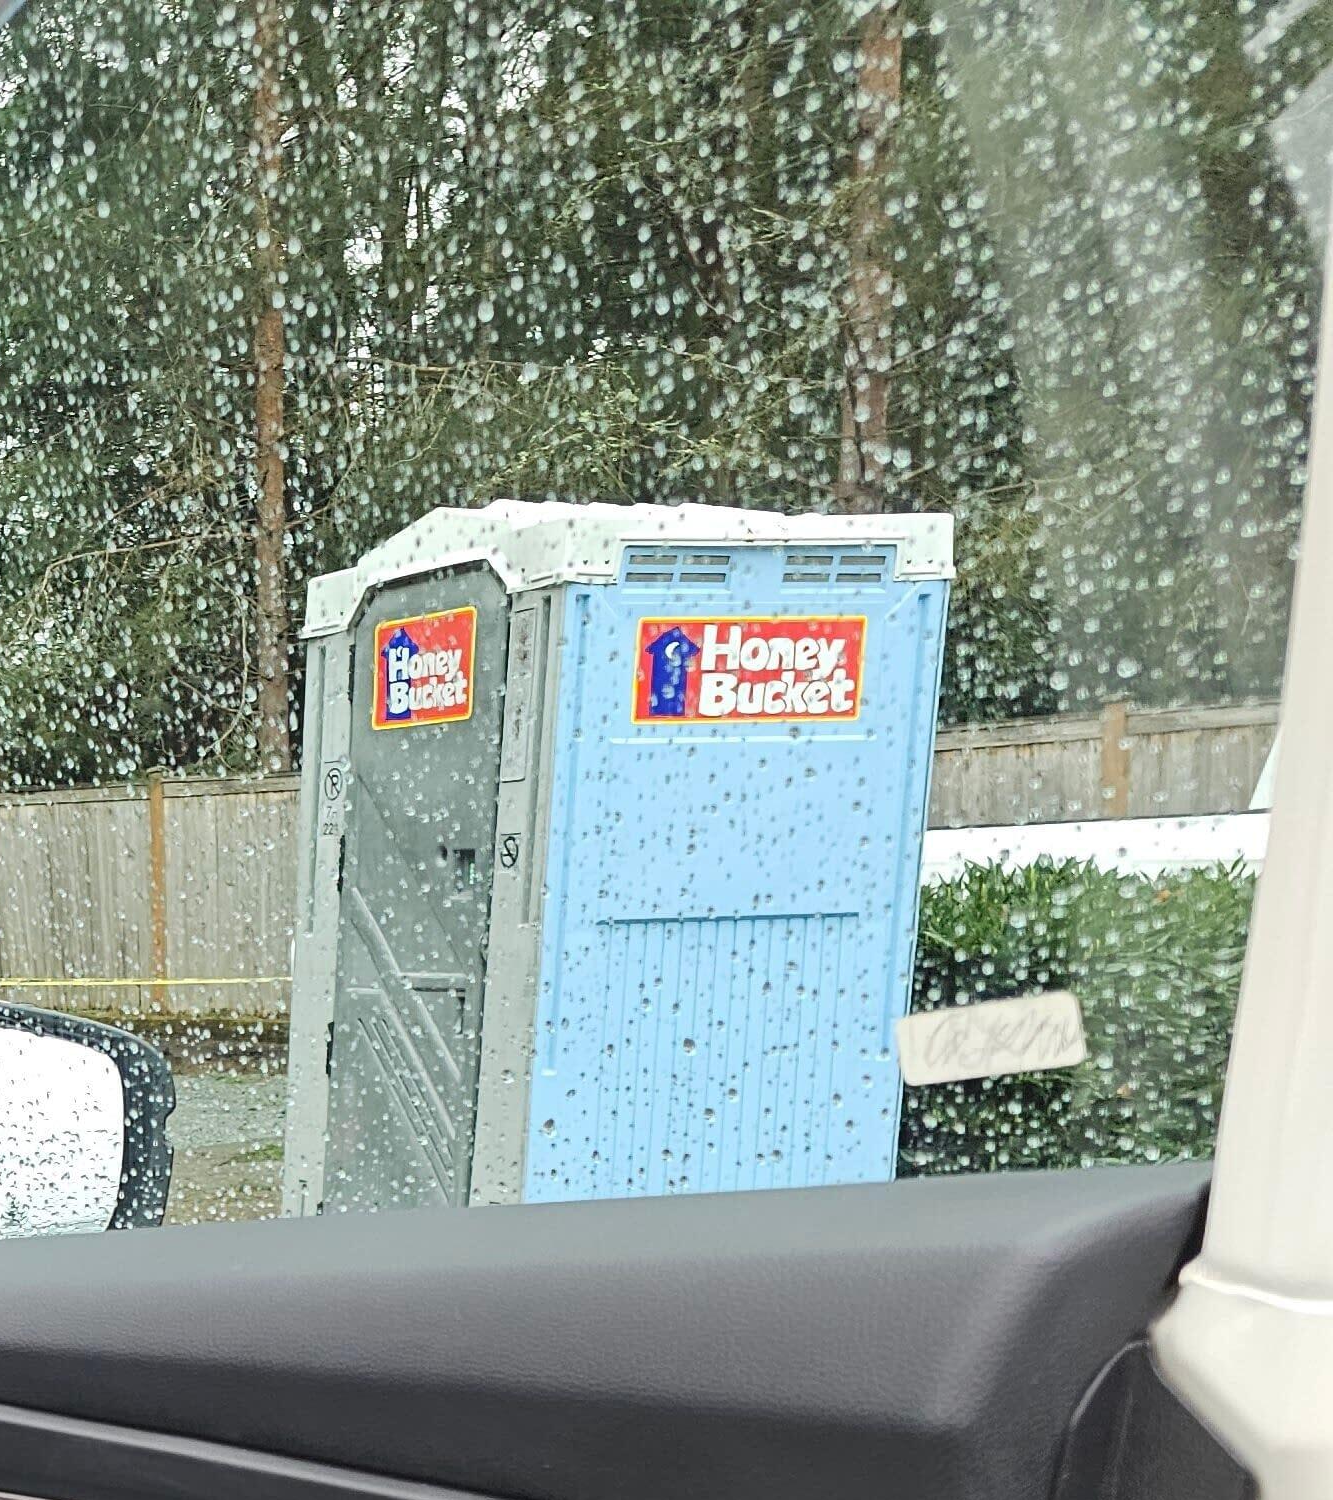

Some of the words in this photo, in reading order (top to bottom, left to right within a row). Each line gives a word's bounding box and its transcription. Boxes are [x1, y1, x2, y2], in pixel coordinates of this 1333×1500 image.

[388, 647, 463, 683] Honey
[700, 624, 847, 680] Honey
[389, 670, 468, 714] Bucket
[698, 668, 856, 717] Bucket
